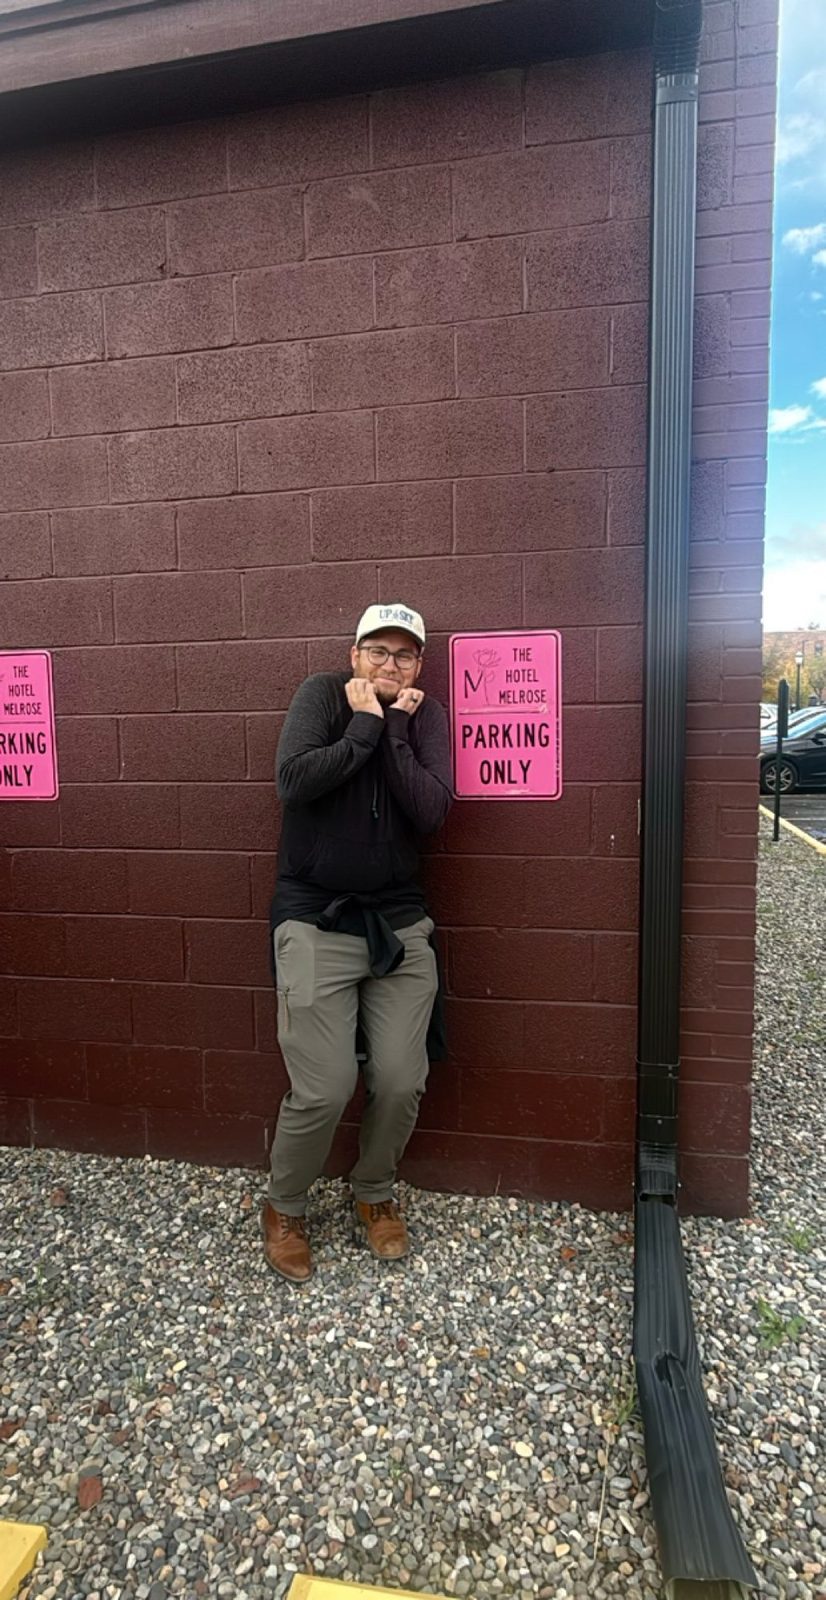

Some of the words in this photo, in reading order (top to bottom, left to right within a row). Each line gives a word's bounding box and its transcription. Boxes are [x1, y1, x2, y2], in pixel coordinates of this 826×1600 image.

[512, 647, 533, 662] THE
[13, 665, 29, 678] THE
[505, 668, 539, 683] HOTEL
[8, 684, 35, 697] HOTEL
[499, 689, 547, 704] MELROSE
[3, 702, 42, 716] MELROSE
[462, 723, 550, 749] PARKING
[479, 759, 531, 785] ONLY
